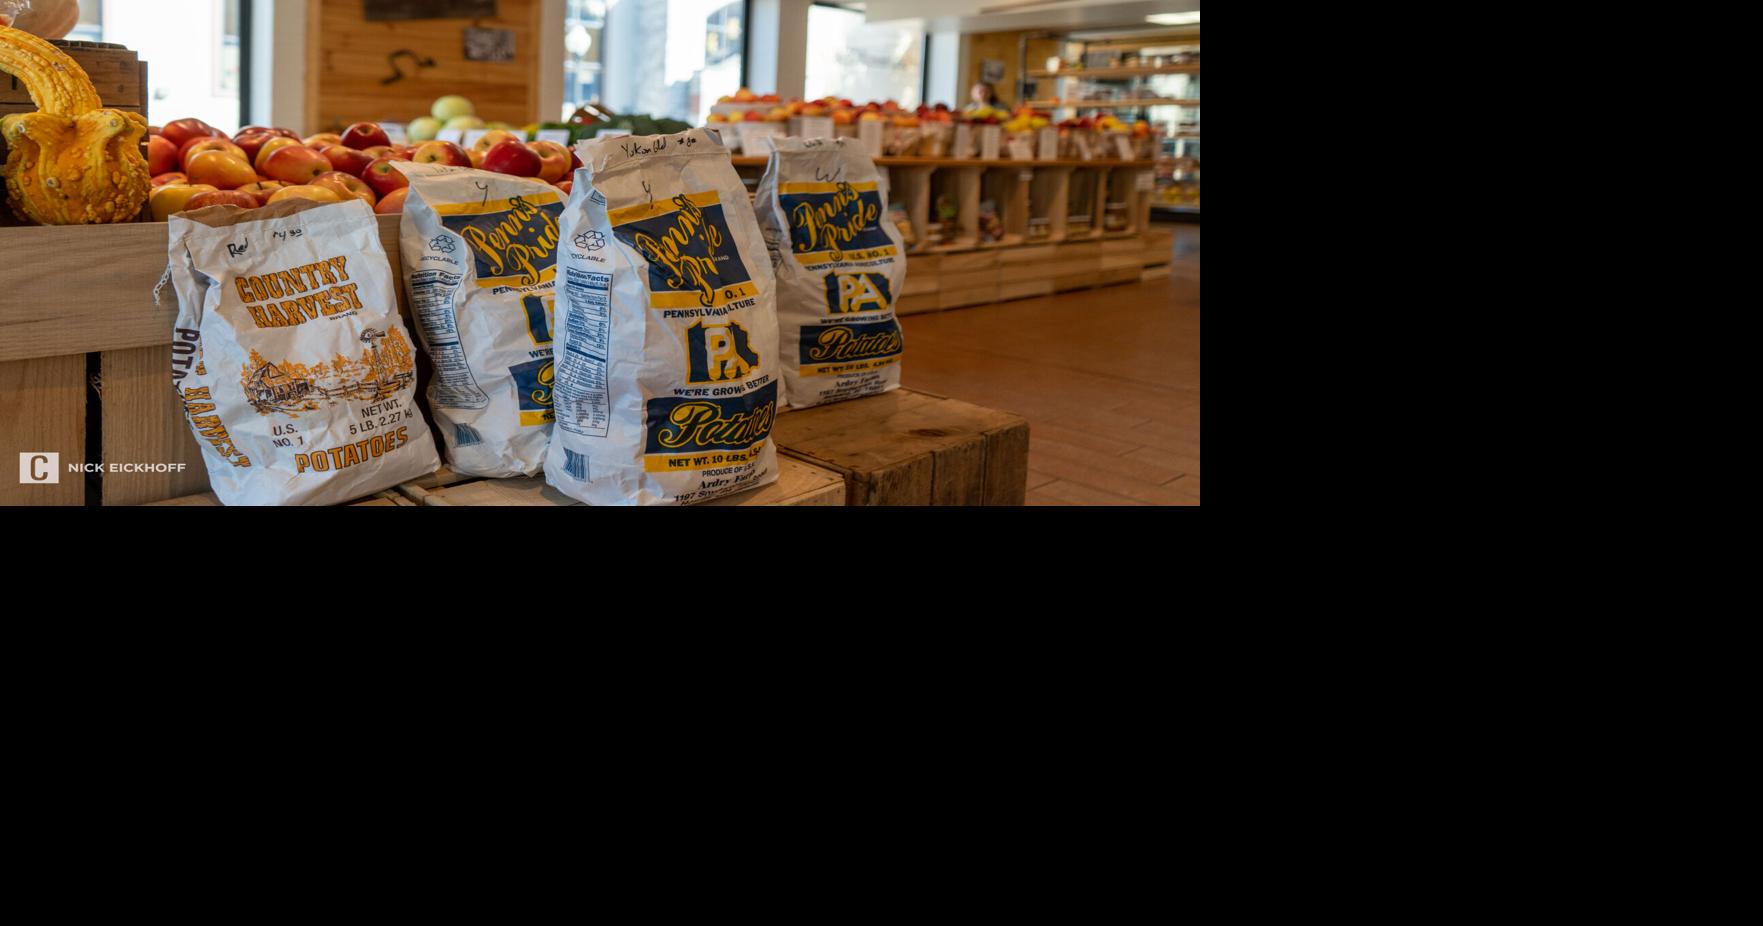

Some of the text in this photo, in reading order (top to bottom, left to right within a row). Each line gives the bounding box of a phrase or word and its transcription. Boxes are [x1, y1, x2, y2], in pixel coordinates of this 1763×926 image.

[821, 199, 878, 262] Pride
[227, 237, 249, 258] Red
[680, 217, 722, 307] Prie
[235, 255, 350, 303] COUNTRY
[838, 273, 888, 313] PA
[246, 283, 363, 329] HARVEST
[705, 328, 751, 379] PA
[809, 326, 901, 360] Potatoes
[674, 388, 709, 396] WE'RE
[361, 398, 403, 419] NET WT.
[273, 424, 299, 437] U.S.
[349, 425, 357, 435] 5
[360, 420, 378, 433] LB.
[380, 411, 401, 427] 2.27
[273, 435, 304, 448] NO. 1
[295, 426, 409, 473] POTATOES
[669, 458, 690, 468] NET
[693, 457, 709, 466] WT.
[712, 455, 723, 464] 10
[726, 453, 748, 462] LBS.
[702, 467, 733, 477] PRODUCE
[698, 478, 731, 490] Ardry
